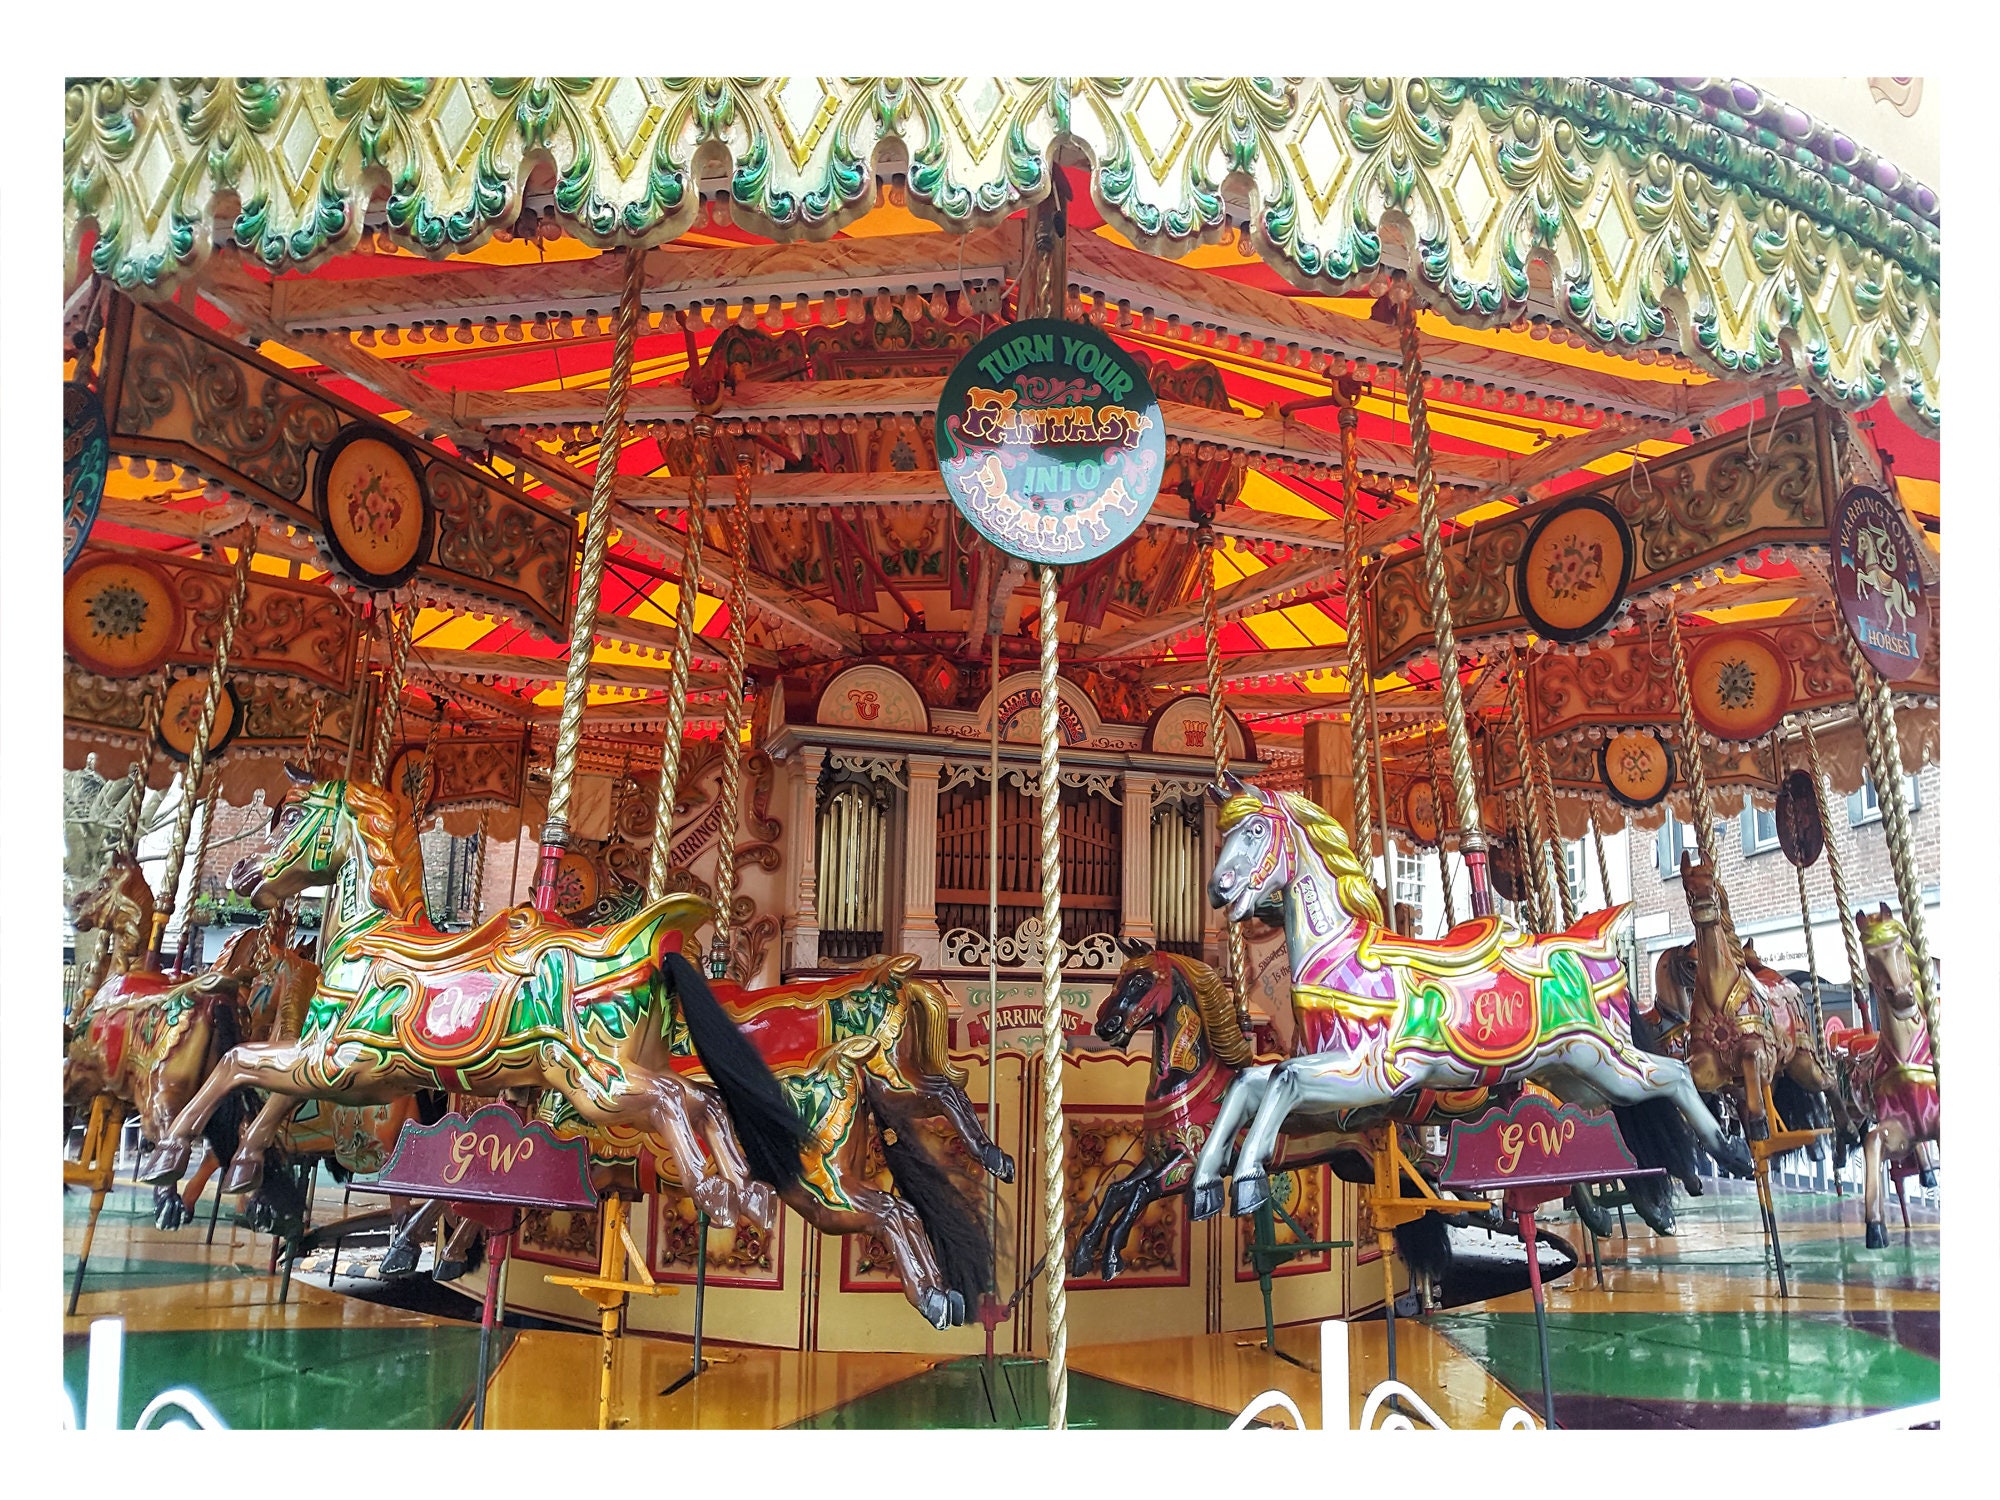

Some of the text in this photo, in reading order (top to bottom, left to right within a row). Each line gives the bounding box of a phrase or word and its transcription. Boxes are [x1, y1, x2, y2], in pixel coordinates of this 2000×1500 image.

[977, 334, 1135, 403] TURN YOUR
[962, 386, 1153, 448] FANTASY
[960, 455, 1138, 553] REALITY
[1024, 459, 1101, 494] INTO
[1840, 496, 1918, 572] WARRINGTON'S
[1868, 629, 1911, 657] HORSES
[997, 690, 1029, 731] RIDE
[1301, 879, 1329, 934] ZORRO
